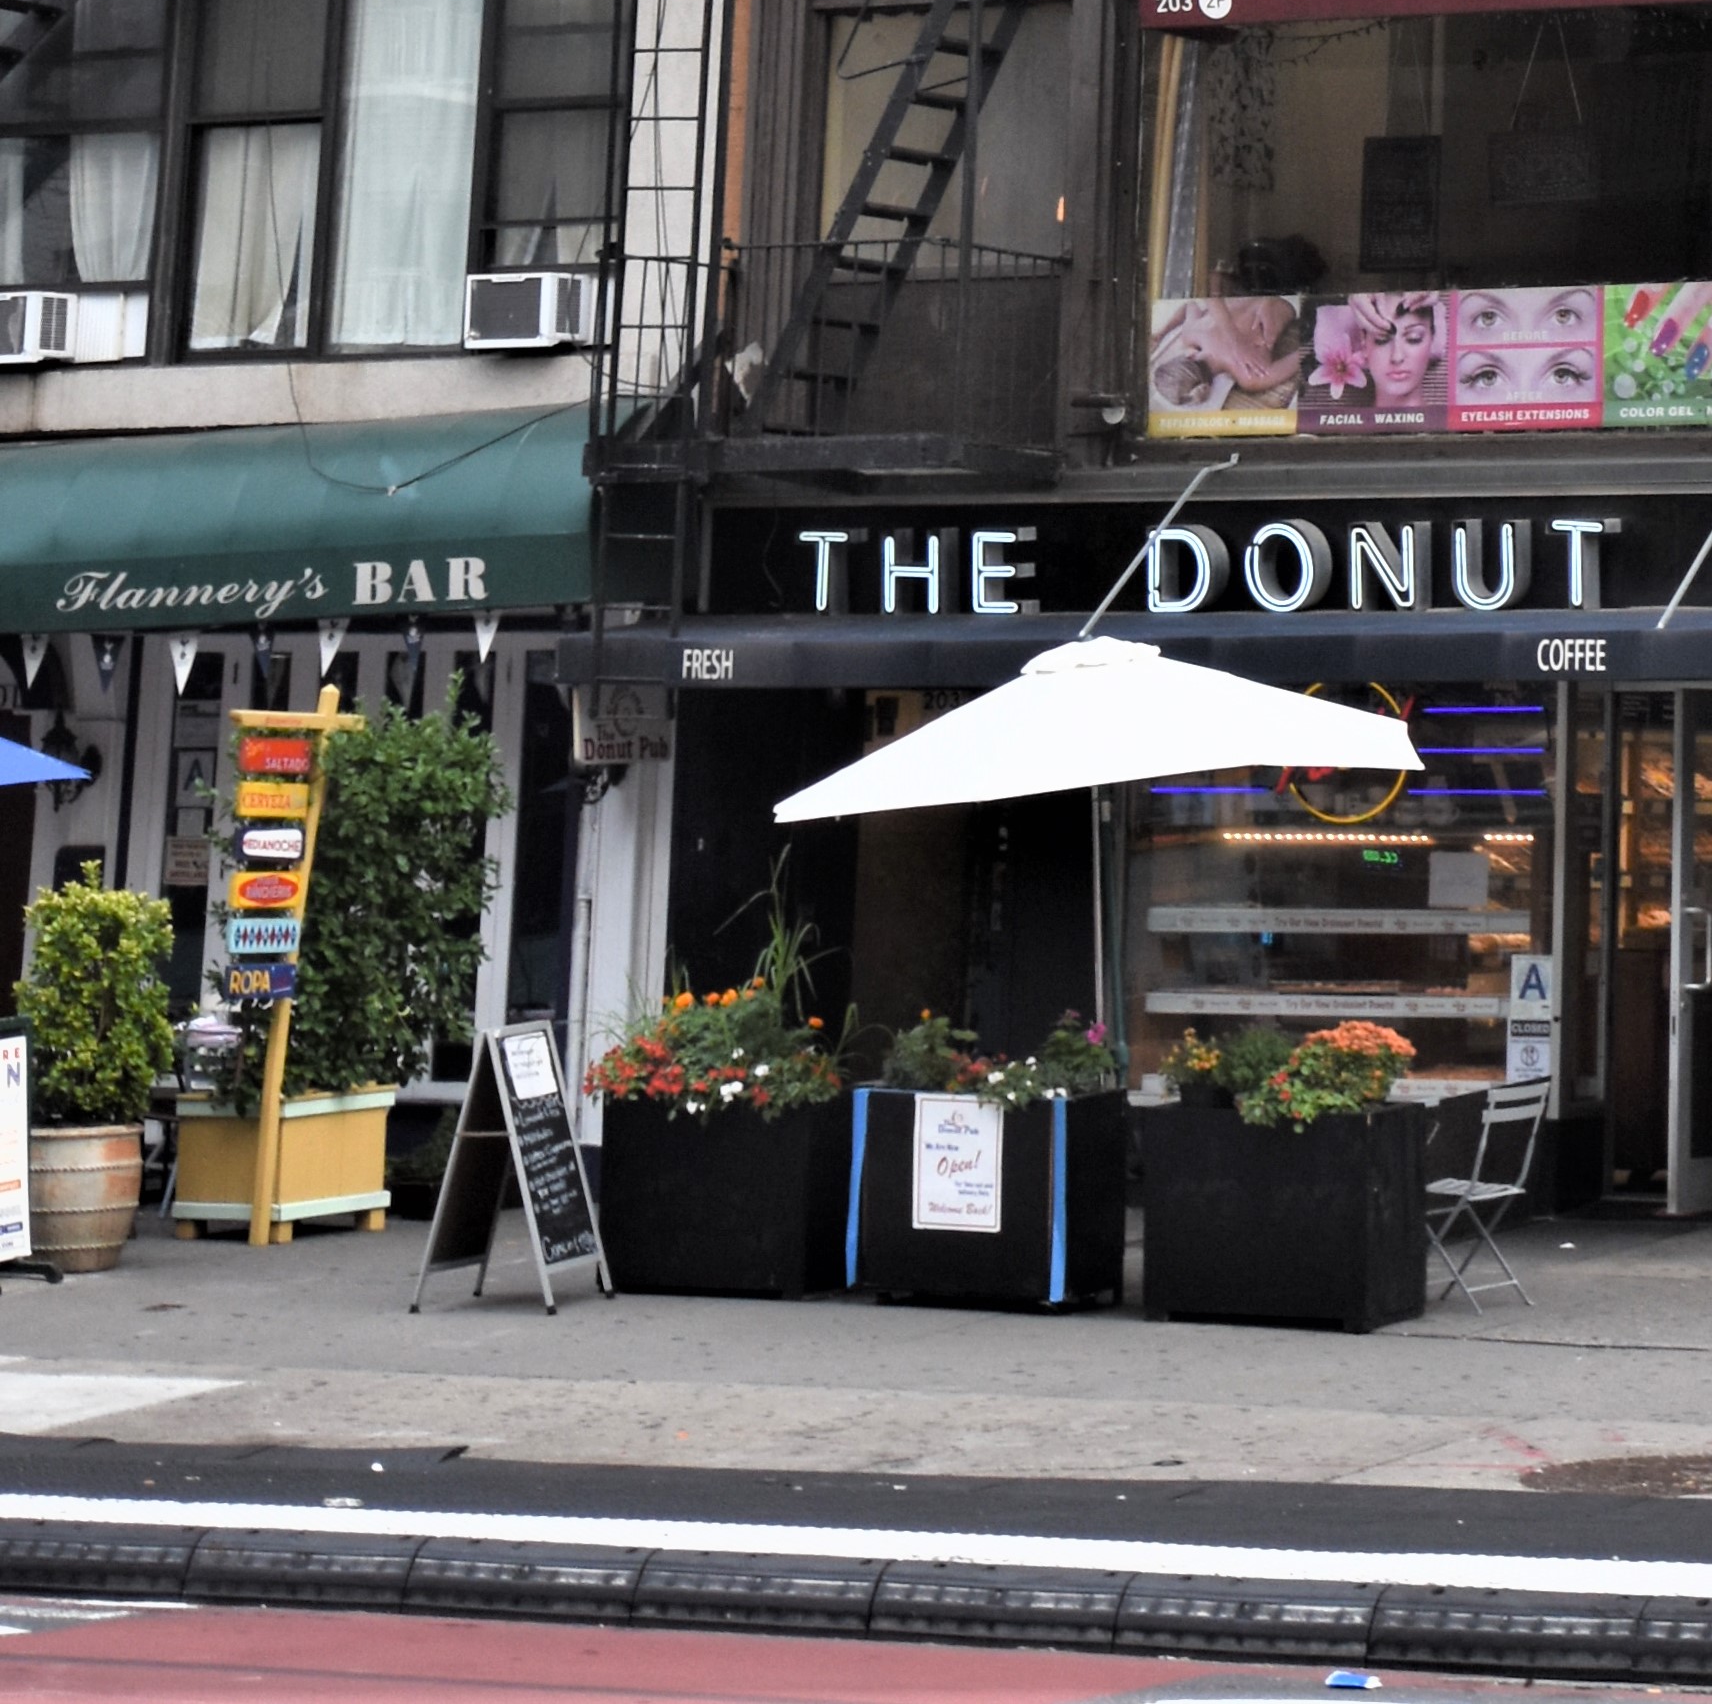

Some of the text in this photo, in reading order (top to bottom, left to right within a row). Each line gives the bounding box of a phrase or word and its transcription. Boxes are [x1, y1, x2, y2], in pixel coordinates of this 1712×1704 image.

[1502, 330, 1549, 342] BEFORE
[1505, 390, 1543, 402] AFTER
[1319, 411, 1425, 426] FACIAL WAXING
[1460, 408, 1590, 423] EYELASH EXTENSIONS
[1619, 406, 1663, 419] COLOR
[1667, 405, 1694, 418] GEL
[799, 526, 1036, 615] THE
[1146, 518, 1621, 615] DONUT
[56, 557, 488, 620] Flannery's BAR
[681, 648, 734, 680] FRESH
[1536, 638, 1607, 672] COFFEE
[584, 736, 670, 761] Donut Pub
[264, 756, 310, 771] SALTADO
[229, 969, 271, 995] ROPA
[1518, 962, 1547, 1000] A
[1511, 1023, 1550, 1034] CLOSED
[936, 1149, 982, 1179] Open!
